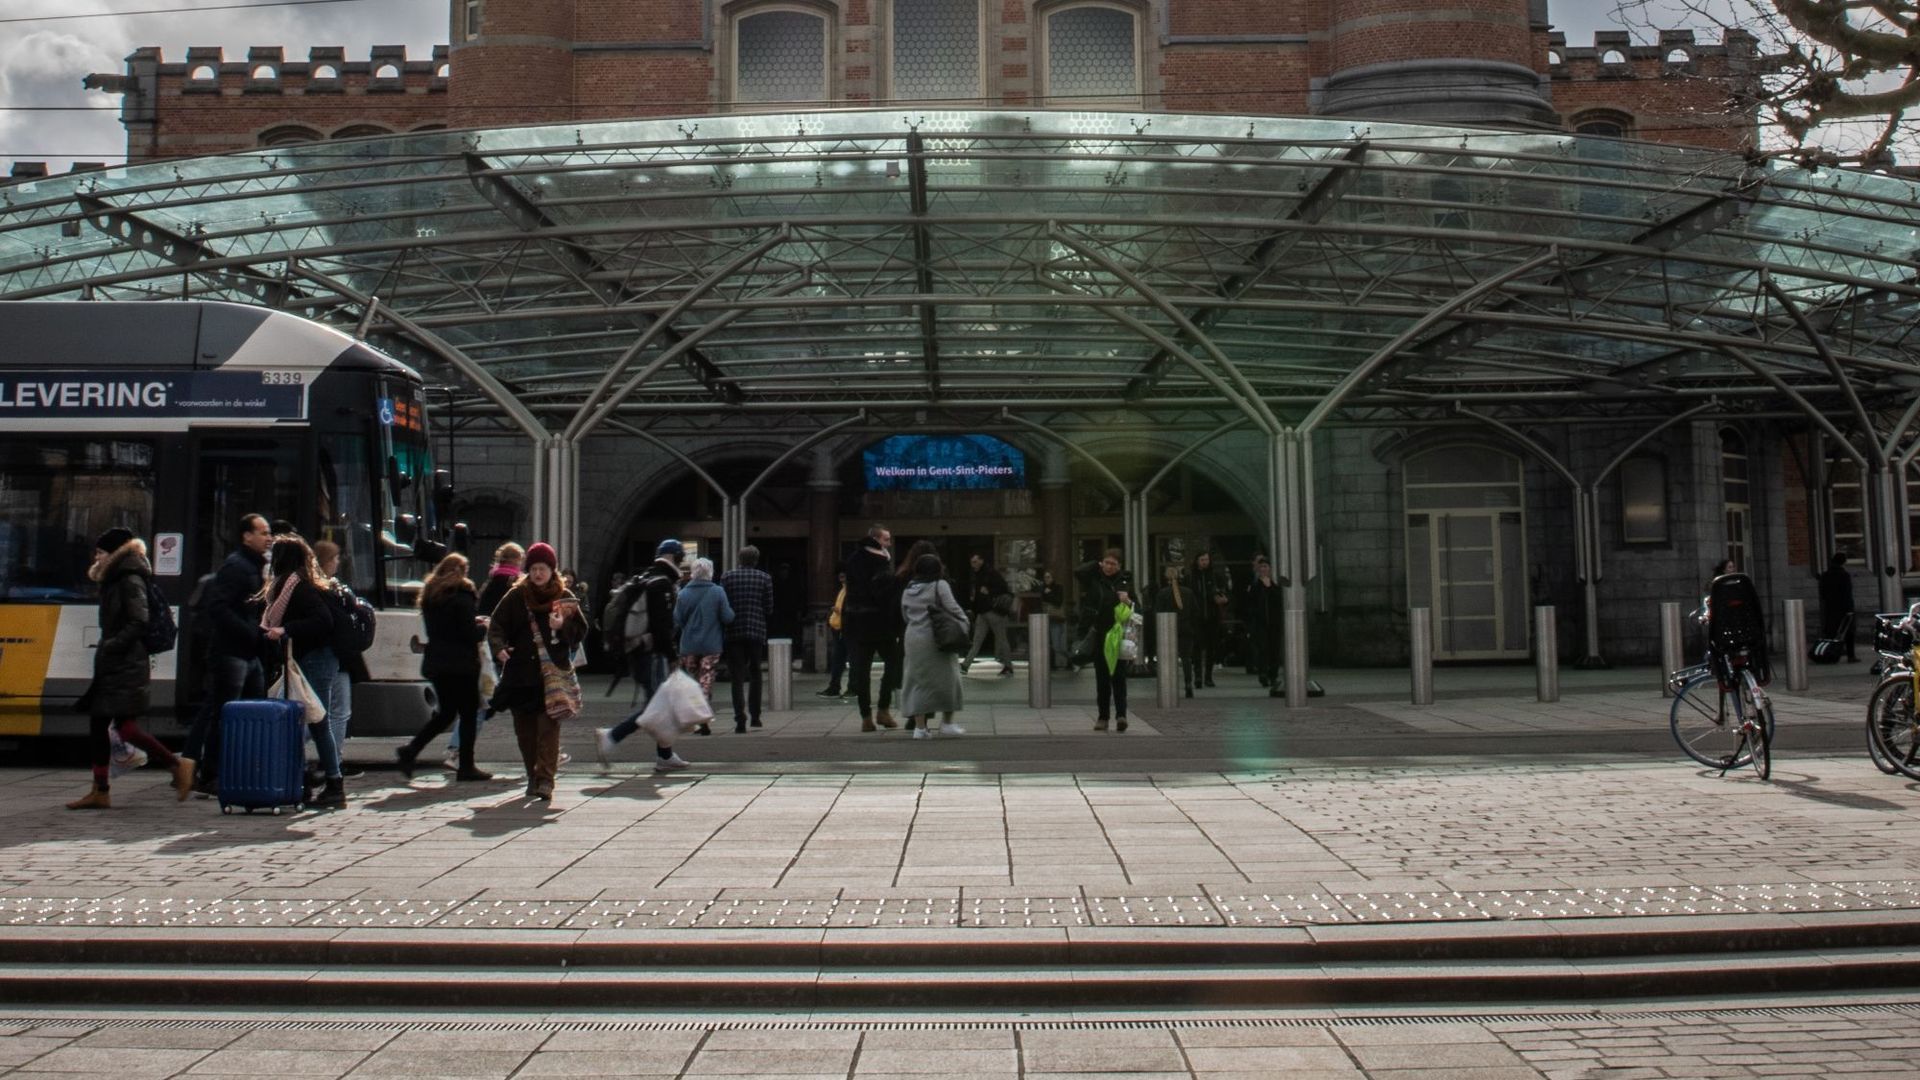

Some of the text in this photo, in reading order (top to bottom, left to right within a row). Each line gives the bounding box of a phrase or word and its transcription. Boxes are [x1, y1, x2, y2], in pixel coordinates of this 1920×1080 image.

[263, 372, 302, 384] 6339
[225, 399, 232, 407] in
[233, 398, 242, 407] de
[244, 399, 266, 407] winkel
[875, 465, 1013, 476] Welkom in Gent-Sint-Pieters
